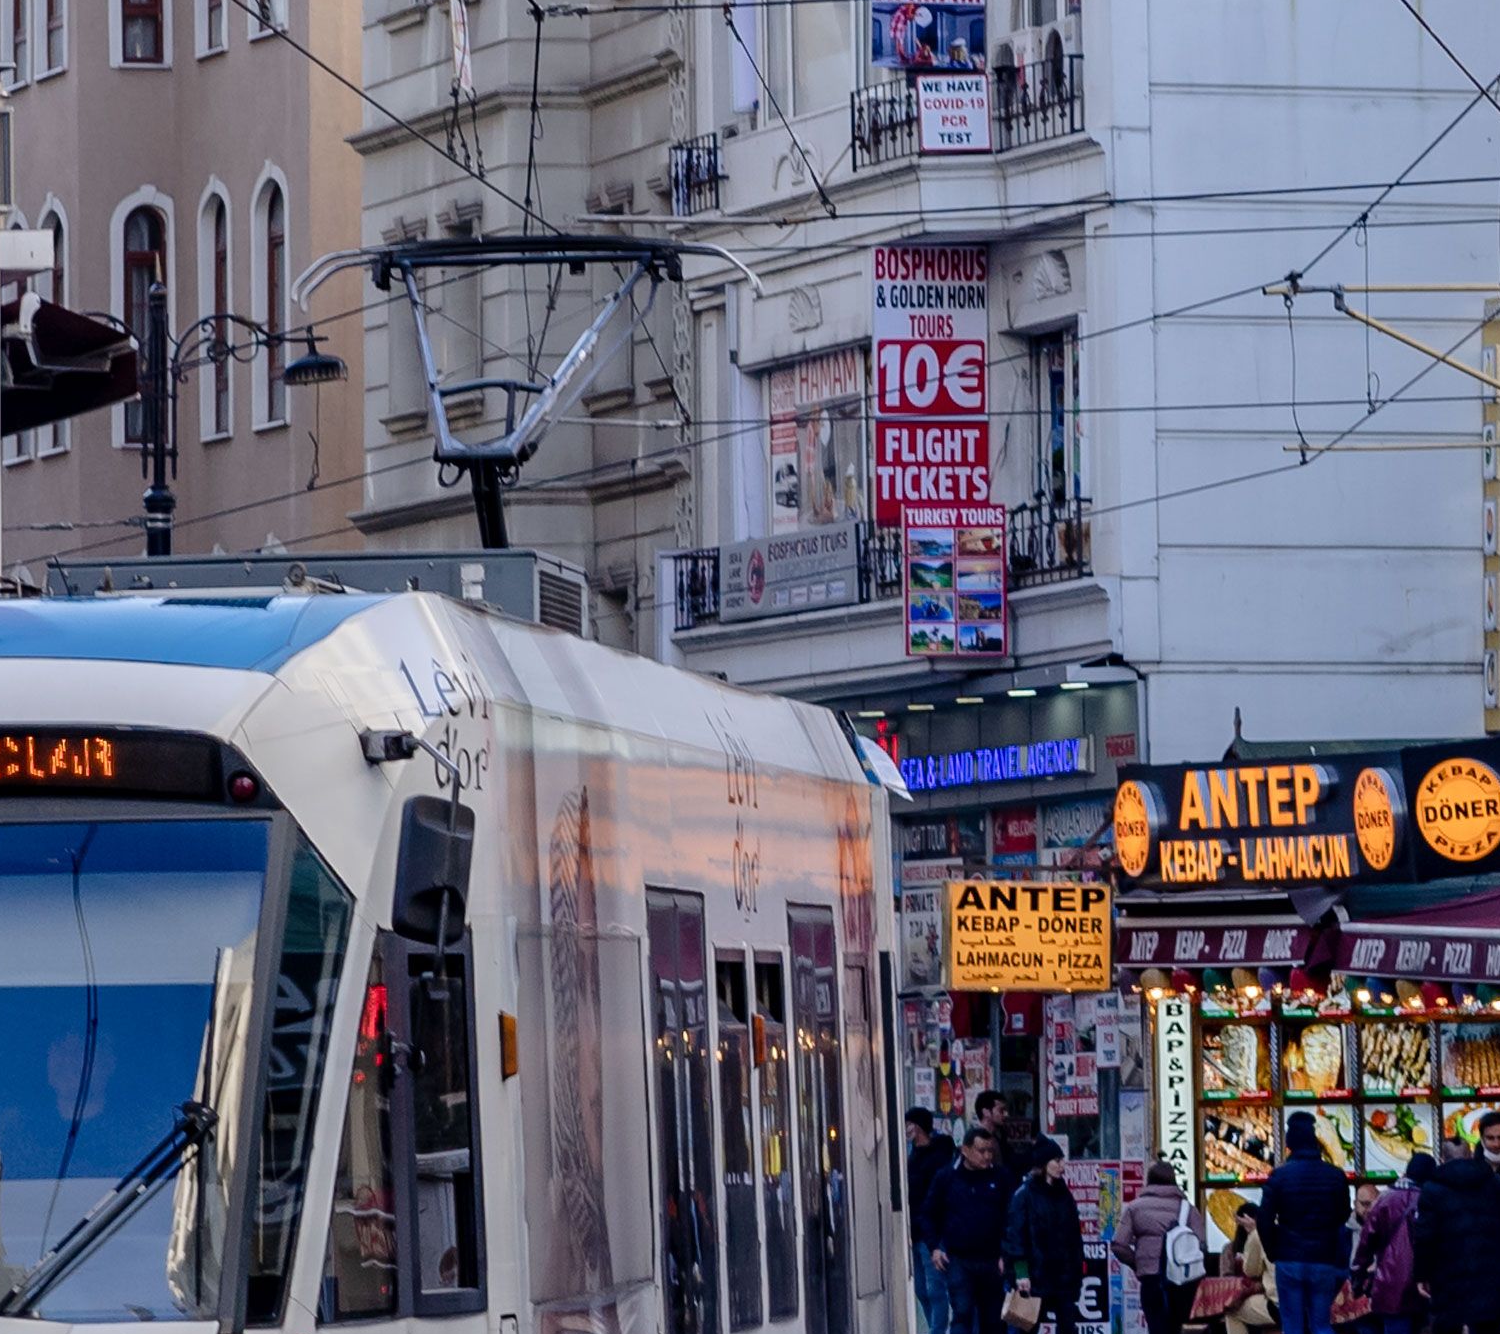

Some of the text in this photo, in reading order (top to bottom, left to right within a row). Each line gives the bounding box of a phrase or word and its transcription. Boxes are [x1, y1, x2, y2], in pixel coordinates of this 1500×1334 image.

[922, 77, 983, 93] WE HAVE
[924, 99, 984, 111] COVID-19
[941, 115, 968, 128] PCR
[939, 133, 972, 146] TEST
[875, 248, 986, 281] BOSPHORUS
[877, 285, 985, 309] & GOLDEN HORN
[909, 315, 954, 339] TOURS
[800, 349, 858, 402] HAMAM
[880, 343, 983, 409] 10€
[885, 427, 981, 463] FLIGHT
[876, 466, 989, 501] TICKETS
[906, 508, 1004, 525] TURKEY TOURS
[901, 739, 1081, 790] SEA & LAND TRAVEL AGENCY
[1425, 766, 1493, 794] KEBAP
[1179, 764, 1321, 831] ANTEP
[1424, 796, 1500, 824] DÖNER
[1117, 819, 1147, 837] DÖNER
[1358, 809, 1390, 830] DÖNER
[1434, 829, 1499, 856] PİZZA
[1159, 834, 1351, 883] KEBAP LAHMACUN
[956, 886, 1106, 913] ANTEP
[957, 913, 1103, 934] KEBAP DÖNER
[957, 948, 1103, 969] LAHMACUN PİZZA
[1129, 932, 1159, 960] ANTEP
[1174, 931, 1205, 960] KEBAP
[1262, 930, 1298, 959] HOUSE
[1351, 939, 1386, 970] ANTEP
[1395, 940, 1430, 970] KEBAP
